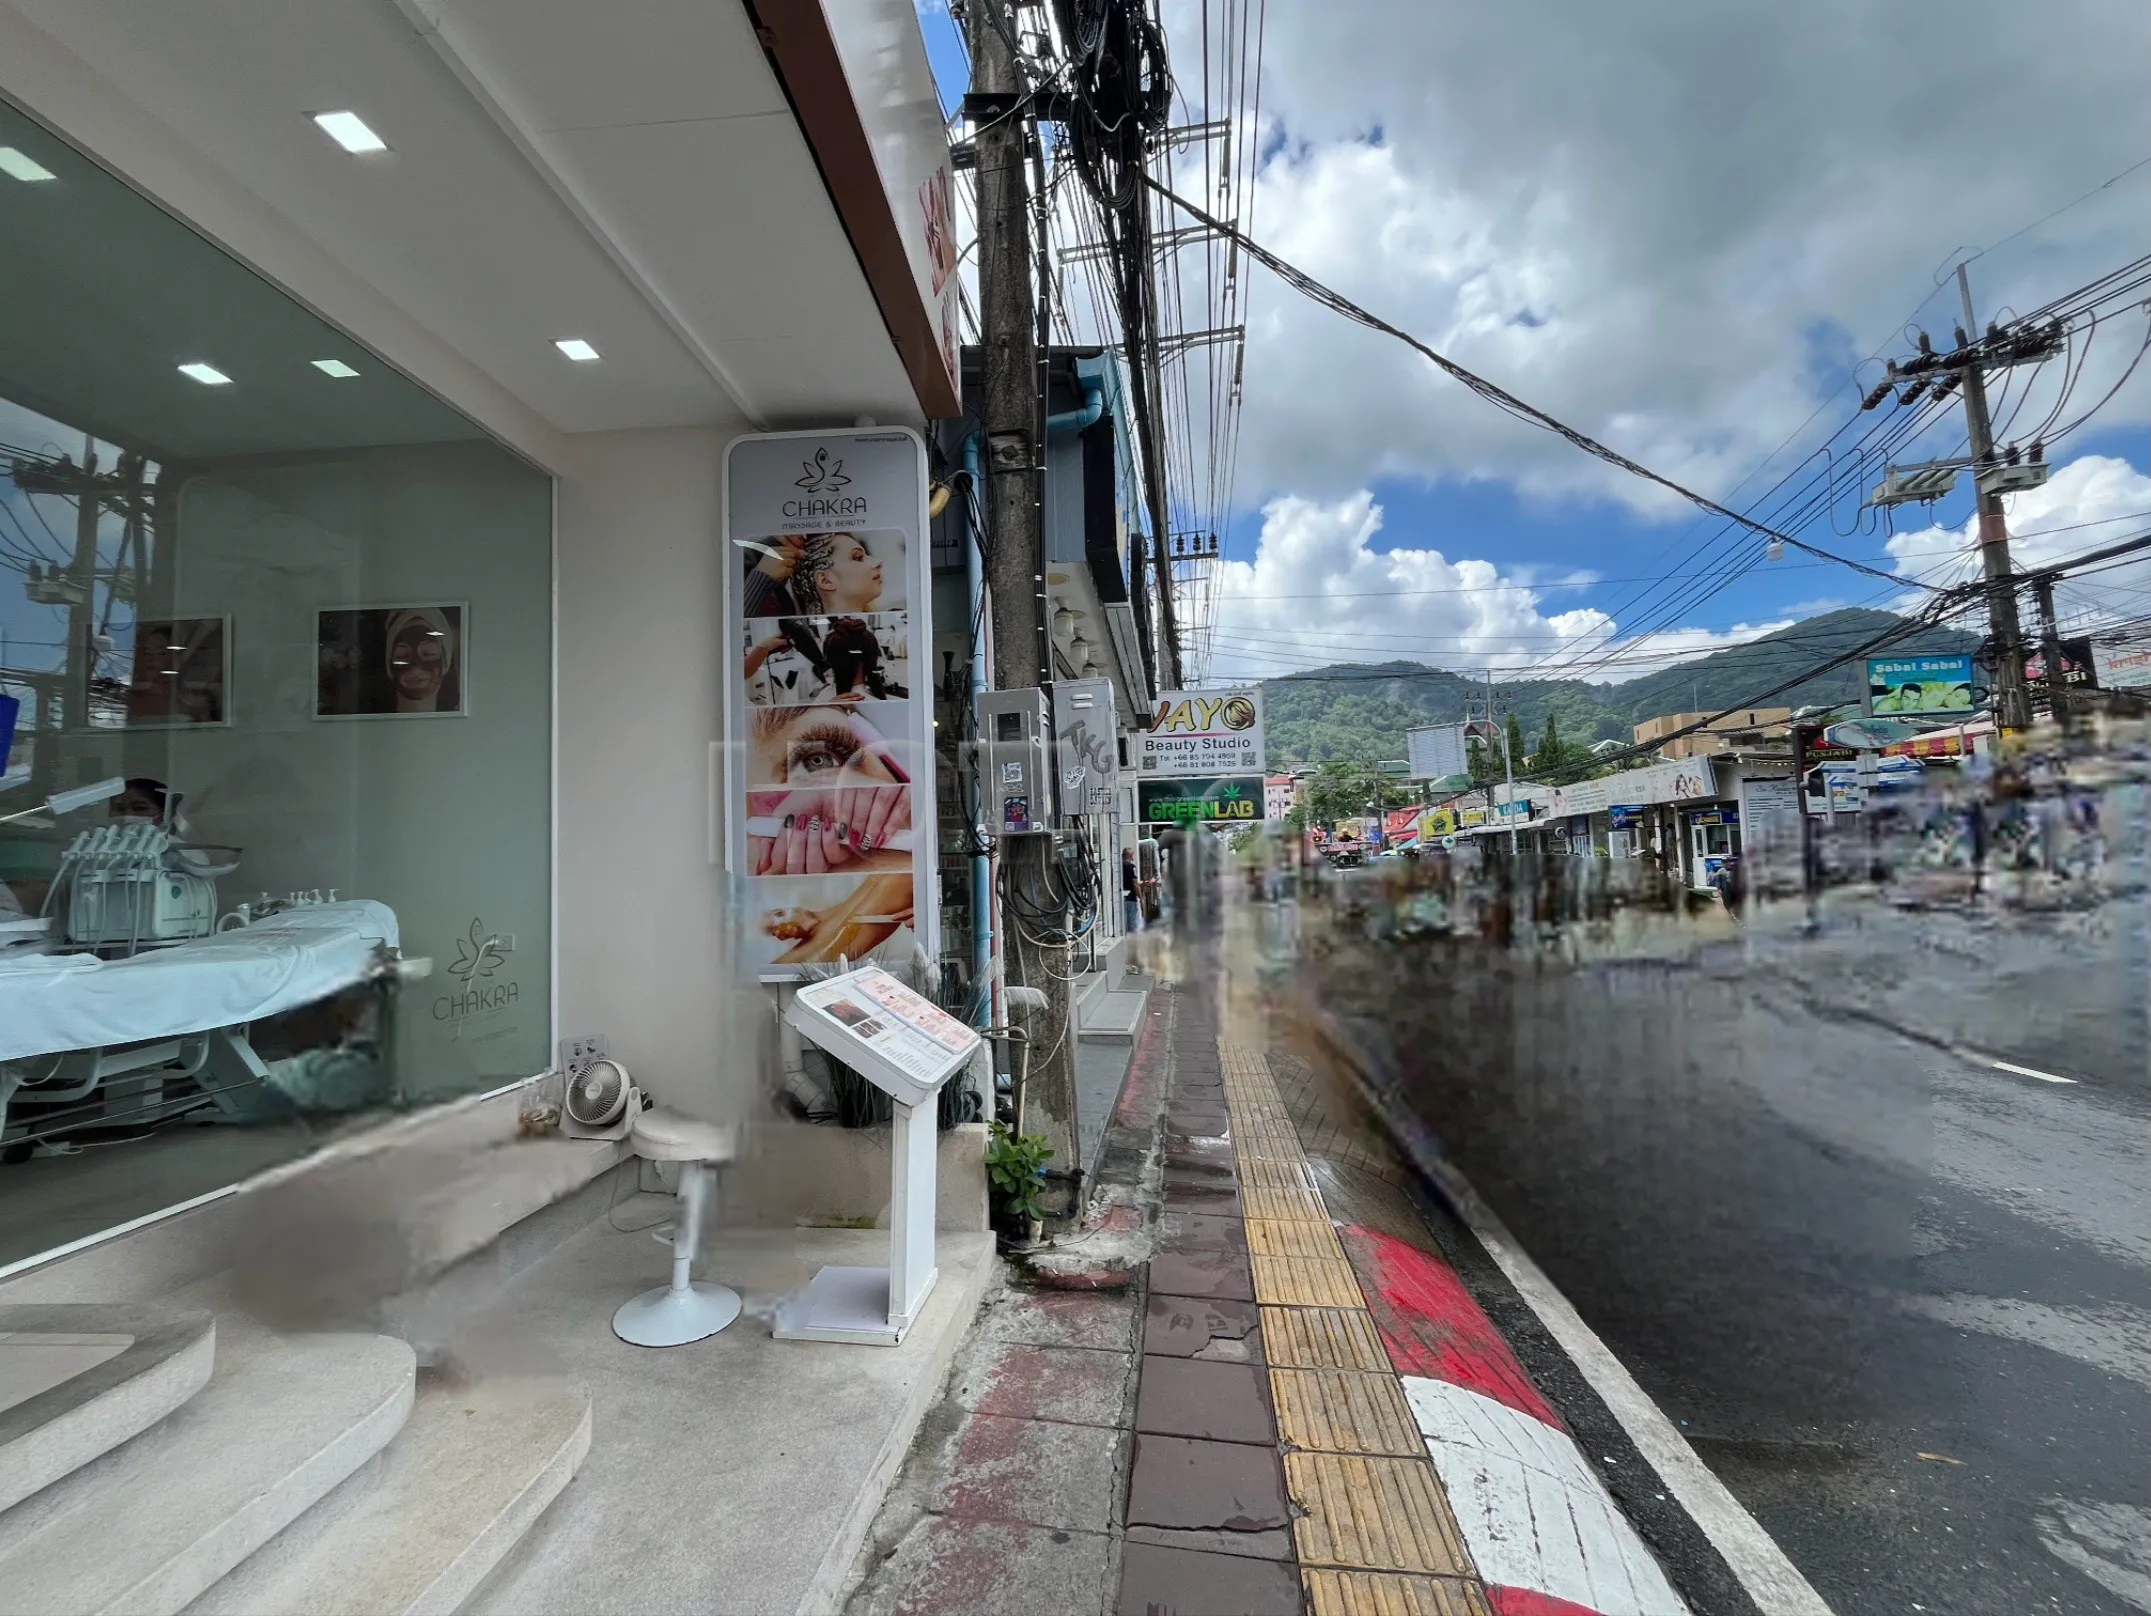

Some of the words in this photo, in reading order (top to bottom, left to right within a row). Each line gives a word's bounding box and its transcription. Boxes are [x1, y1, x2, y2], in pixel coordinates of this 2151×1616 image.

[782, 497, 867, 517] CHAKRA
[781, 522, 822, 530] MASSAGE
[835, 519, 866, 527] BEAUTY
[1145, 739, 1197, 753] Beauty
[1202, 738, 1251, 749] Studio
[1148, 800, 1254, 820] GREENLAB
[432, 981, 519, 1021] CHAKRA
